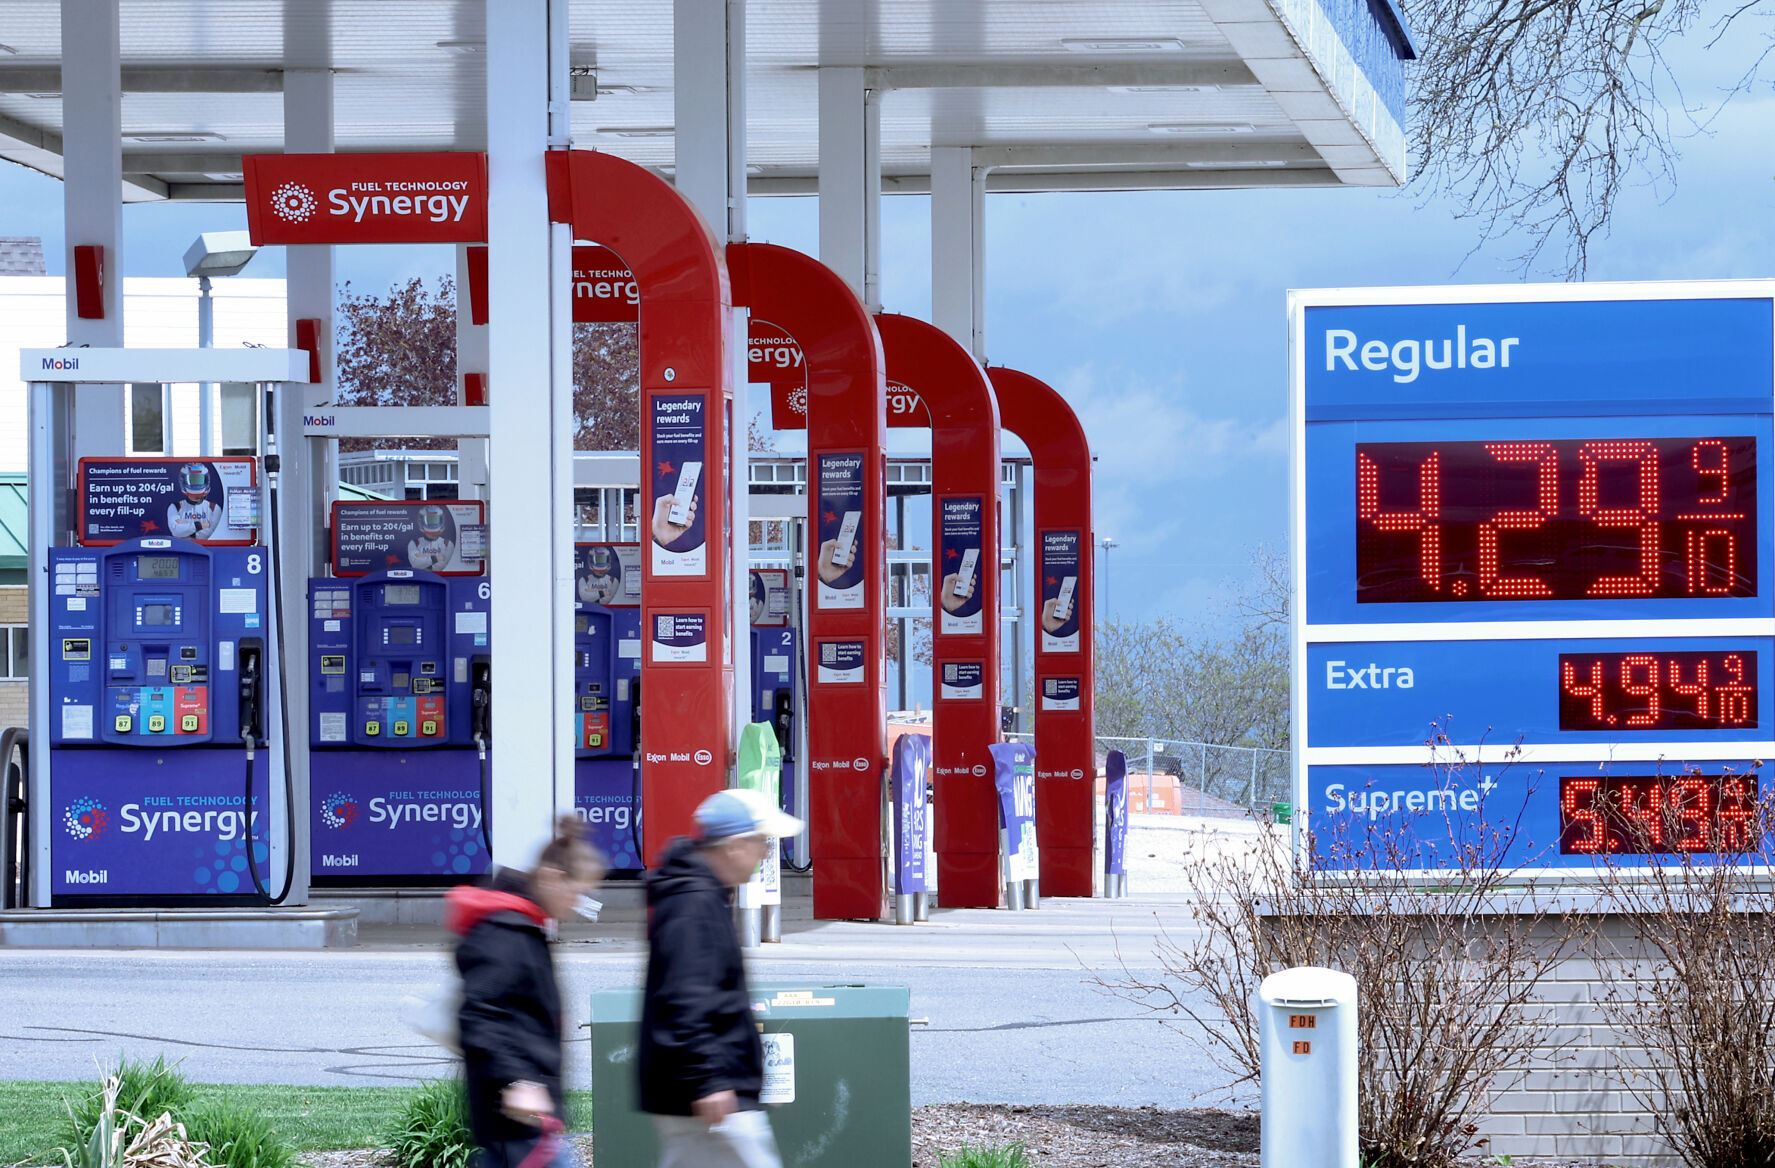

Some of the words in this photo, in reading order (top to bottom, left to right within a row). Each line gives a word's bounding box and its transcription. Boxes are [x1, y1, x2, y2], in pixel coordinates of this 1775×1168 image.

[352, 182, 382, 191] FUEL
[385, 181, 468, 191] TECHNOLOGY
[328, 188, 469, 223] Synergy
[573, 270, 586, 278] EL
[589, 269, 632, 278] TECHNO
[572, 281, 640, 305] nerg
[748, 337, 797, 345] ECHNOLO
[748, 346, 804, 368] ergy
[1325, 324, 1520, 383] Regular
[42, 358, 79, 370] Mobil
[656, 399, 702, 413] Legendary
[303, 415, 335, 426] Mobil
[656, 412, 690, 424] rewards
[822, 458, 861, 469] Legendary
[89, 467, 122, 475] Champions
[822, 469, 851, 479] rewards
[89, 483, 111, 493] Earn
[112, 485, 124, 494] up
[126, 484, 137, 492] to
[138, 482, 174, 494] 20¢/gal
[89, 494, 99, 504] in
[100, 494, 138, 504] benefits
[140, 496, 152, 504] on
[89, 508, 115, 518] every
[117, 506, 145, 517] fill-up
[944, 502, 980, 513] Legendary
[184, 511, 206, 520] Mobil
[944, 512, 970, 520] rewards
[1359, 441, 1659, 597] 4.29
[1692, 440, 1728, 504] 9
[341, 523, 359, 531] Earn
[360, 524, 371, 532] up
[372, 523, 381, 531] to
[383, 522, 414, 532] 20¢/gal
[341, 533, 349, 541] in
[350, 532, 383, 540] benefits
[1045, 534, 1077, 544] Legendary
[341, 544, 363, 552] every
[364, 542, 389, 552] fill-up
[1045, 543, 1069, 551] rewards
[246, 554, 262, 575] 8
[1687, 529, 1735, 594] 10
[478, 582, 491, 600] 6
[781, 631, 792, 646] 2
[1326, 660, 1415, 690] Extra
[1564, 656, 1707, 725] 4.94
[1723, 654, 1743, 685] 9
[1720, 692, 1747, 724] 10
[118, 720, 128, 728] 87
[646, 752, 667, 764] Exxon
[670, 752, 690, 761] Mobil
[812, 761, 830, 771] Exxon
[832, 760, 850, 769] Mobil
[144, 796, 173, 806] FUEL
[389, 791, 413, 800] FUEL
[417, 790, 481, 799] TECHNOLOG
[584, 795, 633, 803] TECHNOLO
[369, 797, 482, 829] Synergy
[574, 806, 642, 830] nerg
[1565, 780, 1709, 850] 5.49
[120, 803, 258, 841] Synergy
[322, 854, 359, 867] Mobil
[65, 870, 108, 884] Mobil
[1290, 1015, 1315, 1025] FDH
[1294, 1041, 1310, 1054] FD
